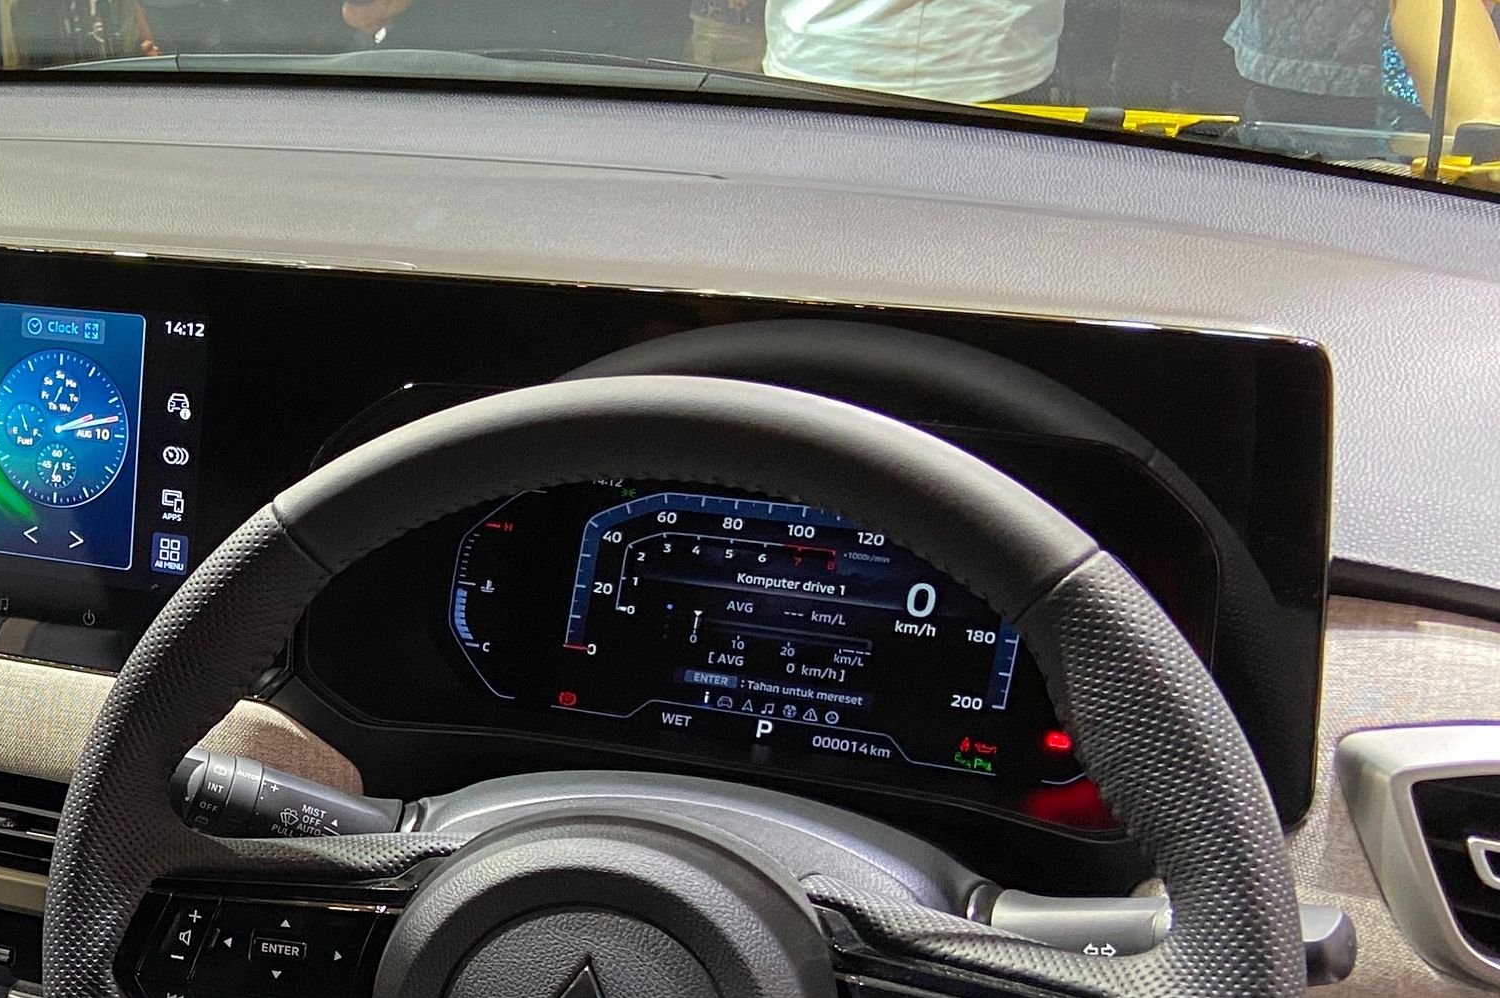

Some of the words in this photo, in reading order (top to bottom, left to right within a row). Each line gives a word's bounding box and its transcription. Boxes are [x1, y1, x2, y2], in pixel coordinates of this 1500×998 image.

[48, 320, 79, 336] Clock
[165, 320, 205, 337] 14:12
[17, 436, 33, 445] Fuel
[76, 429, 92, 439] AUG
[95, 428, 110, 440] 10
[162, 512, 182, 522] APPS
[657, 511, 677, 524] 60
[722, 517, 743, 531] 80
[503, 522, 513, 532] H
[787, 524, 815, 538] 100
[602, 530, 622, 543] 40
[857, 531, 885, 546] 120
[663, 543, 671, 553] 3
[692, 545, 701, 555] 4
[725, 549, 733, 559] 5
[637, 552, 645, 562] 2
[758, 554, 767, 563] 6
[164, 561, 184, 571] MENU
[632, 576, 638, 586] 1
[736, 573, 800, 591] Komputer
[803, 581, 835, 595] drive
[839, 585, 846, 596] 1
[593, 582, 612, 595] 20
[906, 583, 937, 617] 0
[626, 605, 635, 615] 0
[726, 600, 754, 613] AVG
[811, 610, 847, 626] km/L
[894, 620, 936, 637] km/h
[966, 629, 996, 644] 180
[482, 642, 490, 652] C
[689, 634, 697, 643] 0
[731, 639, 745, 650] 10
[780, 646, 795, 657] 20
[833, 653, 864, 667] km/L
[717, 654, 744, 666] AVG
[786, 663, 795, 674] 0
[801, 665, 837, 680] km/h
[693, 671, 728, 686] ENTER
[747, 680, 780, 694] Tahan
[782, 686, 814, 699] untuk
[816, 691, 863, 705] mereset
[950, 695, 983, 710] 200
[661, 712, 692, 727] WET
[755, 719, 773, 738] P
[812, 735, 867, 755] 000014
[870, 745, 890, 758] km
[207, 782, 224, 794] INT
[199, 801, 218, 813] OFF
[302, 804, 327, 819] MIST
[302, 815, 321, 827] OFF
[271, 823, 294, 837] PULL
[261, 942, 300, 957] ENTER
